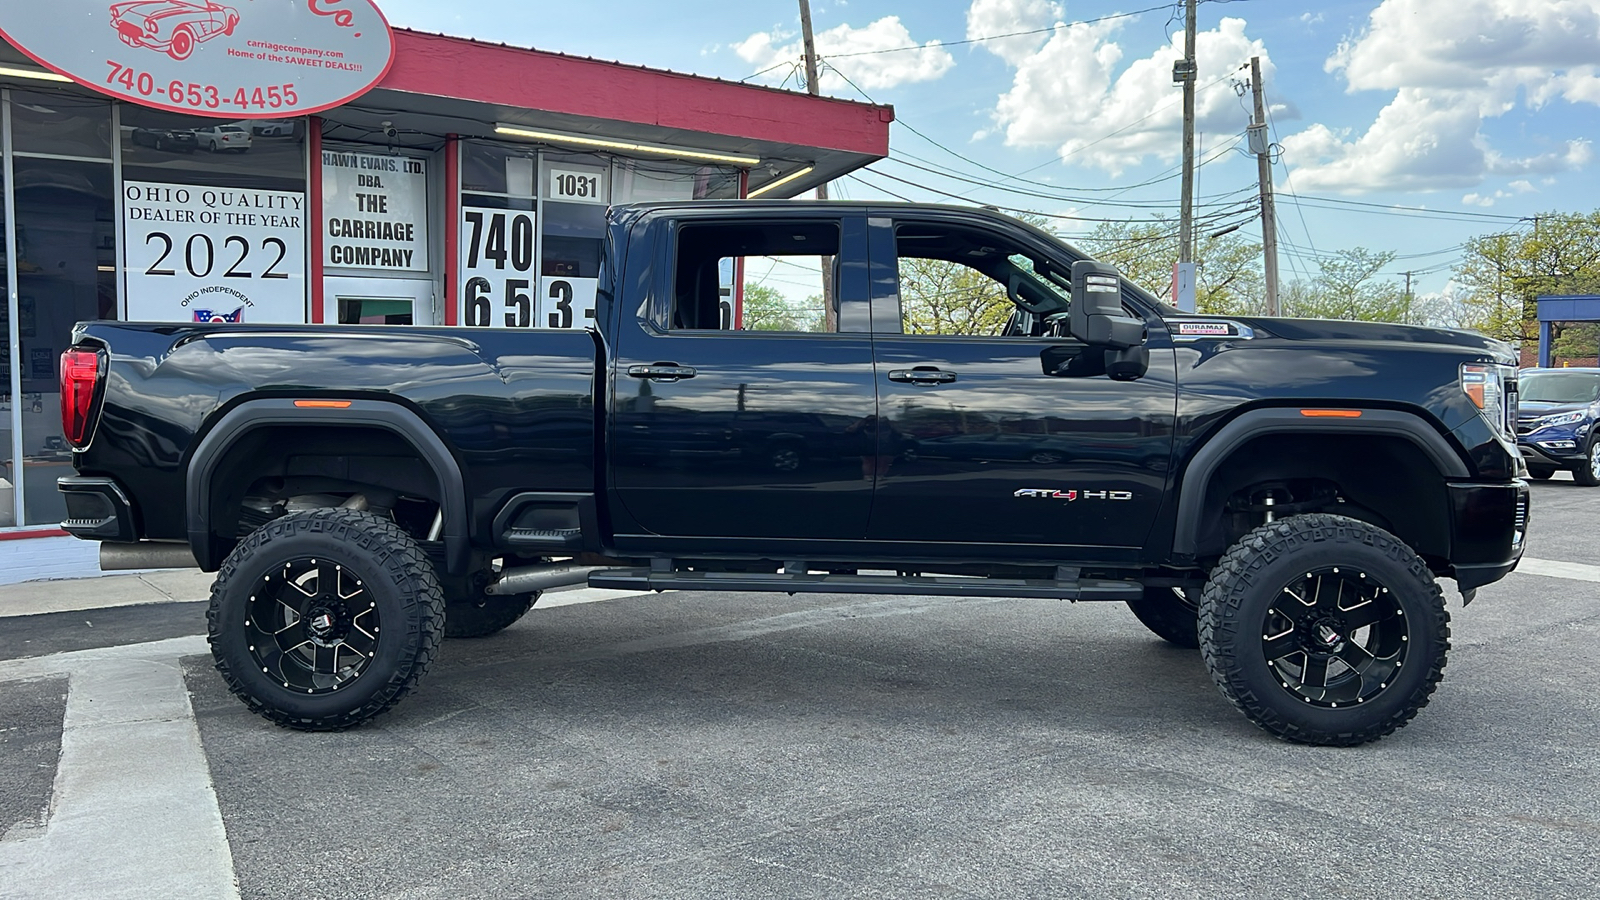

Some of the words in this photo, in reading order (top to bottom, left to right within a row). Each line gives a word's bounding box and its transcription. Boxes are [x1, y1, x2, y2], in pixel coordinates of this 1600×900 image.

[227, 48, 254, 59] Home
[256, 52, 267, 61] of
[268, 53, 283, 63] the
[285, 55, 323, 68] SAWEET
[325, 60, 363, 72] DEALS!!!
[247, 39, 344, 59] carriagecompany.com
[106, 59, 299, 110] 740-653-4455
[360, 156, 399, 172] EVANS.
[403, 161, 424, 175] LTD.
[357, 174, 384, 189] DBA.
[556, 173, 597, 198] 1031
[126, 186, 190, 204] OHIO
[202, 190, 303, 210] QUALITY
[355, 192, 388, 214] THE
[129, 207, 195, 223] DEALER
[199, 211, 221, 224] OF
[224, 212, 257, 226] THE
[260, 214, 301, 228] YEAR
[329, 217, 414, 242] CARRIAGE
[465, 211, 533, 272] 740
[144, 231, 289, 279] 2022
[330, 244, 414, 268] COMPANY
[180, 290, 200, 307] OHIO
[200, 286, 255, 308] INDEPENDENT
[1013, 488, 1078, 501] AT4
[1083, 490, 1133, 500] HD
